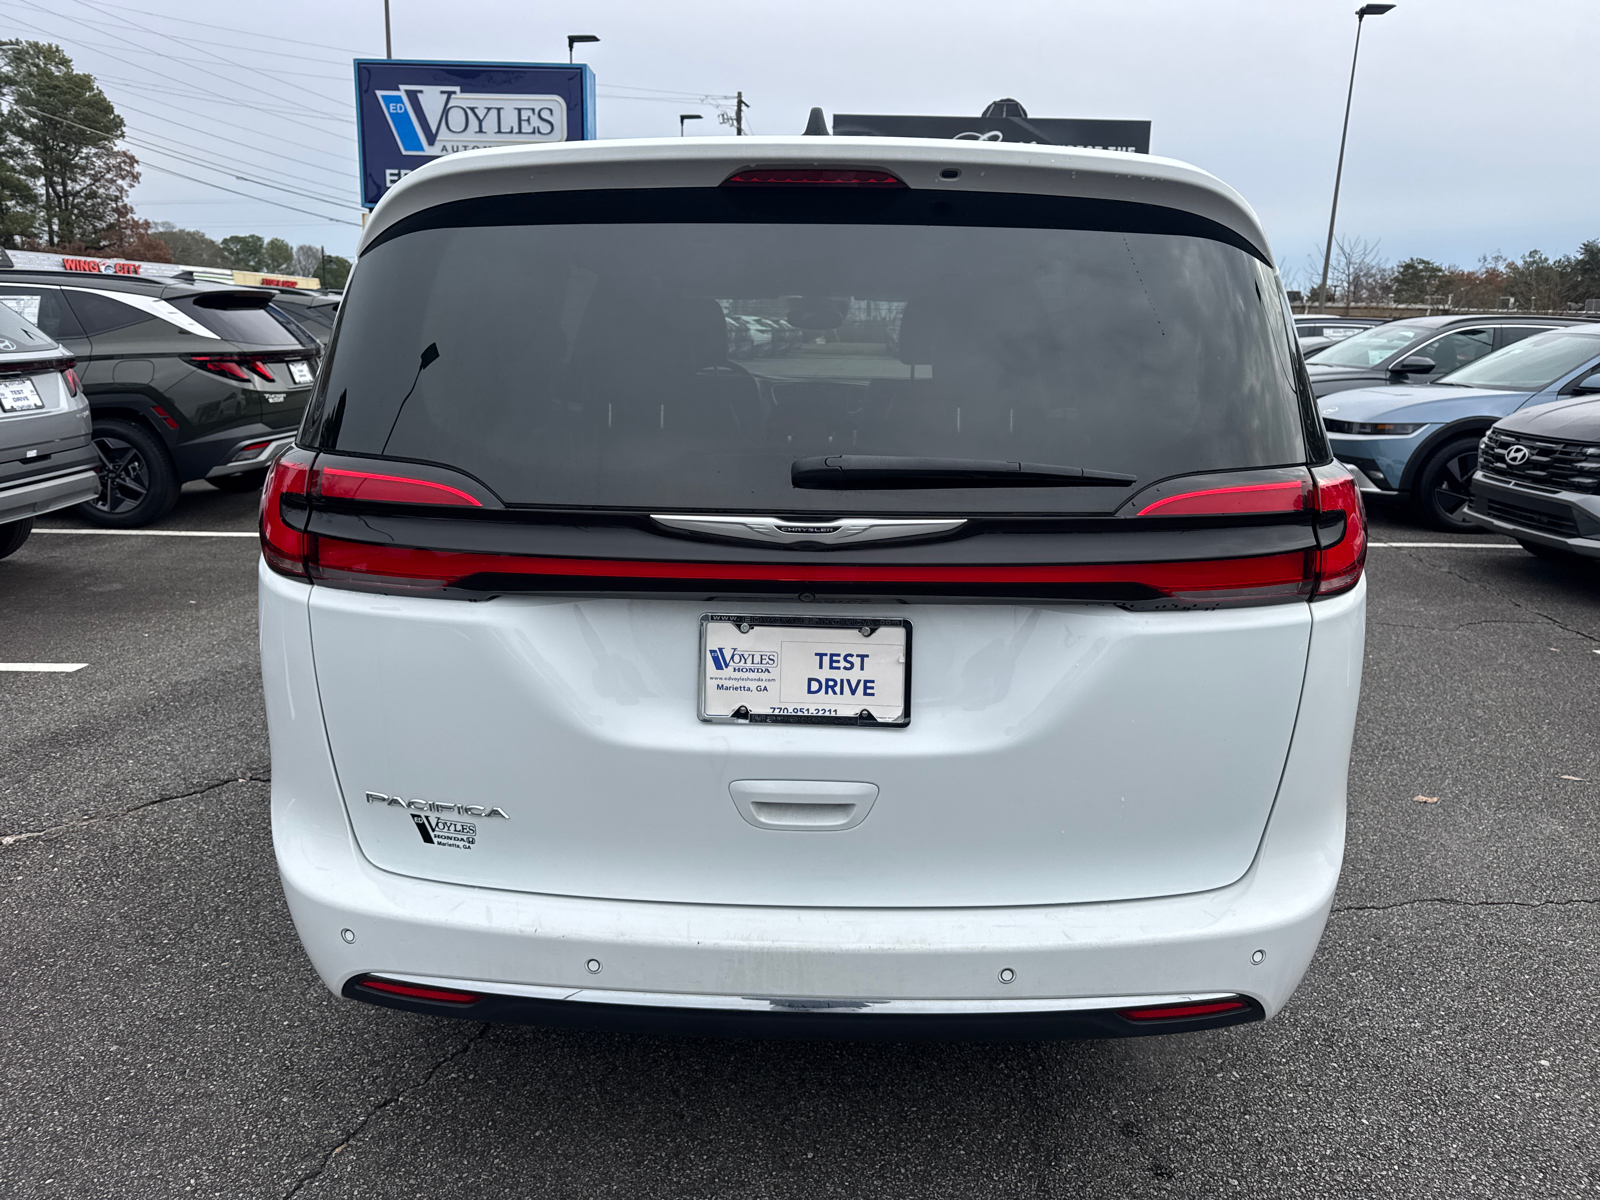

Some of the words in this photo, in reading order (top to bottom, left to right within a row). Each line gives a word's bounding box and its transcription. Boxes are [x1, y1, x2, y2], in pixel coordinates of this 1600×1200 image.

[389, 103, 405, 114] ED
[404, 89, 554, 147] VOYLES
[63, 258, 99, 273] WING
[115, 262, 141, 275] CITY
[717, 647, 776, 669] VOYLES
[814, 652, 870, 672] TEST
[709, 675, 777, 683] www.edvoyleshonda.com
[716, 683, 753, 693] Marietta,
[755, 685, 769, 693] GA
[806, 677, 876, 697] DRIVE
[365, 790, 511, 820] PACIFICA
[413, 816, 424, 824] ED
[424, 815, 476, 835] VOYLES
[433, 833, 467, 843] HONDA
[436, 840, 462, 850] Marietta,
